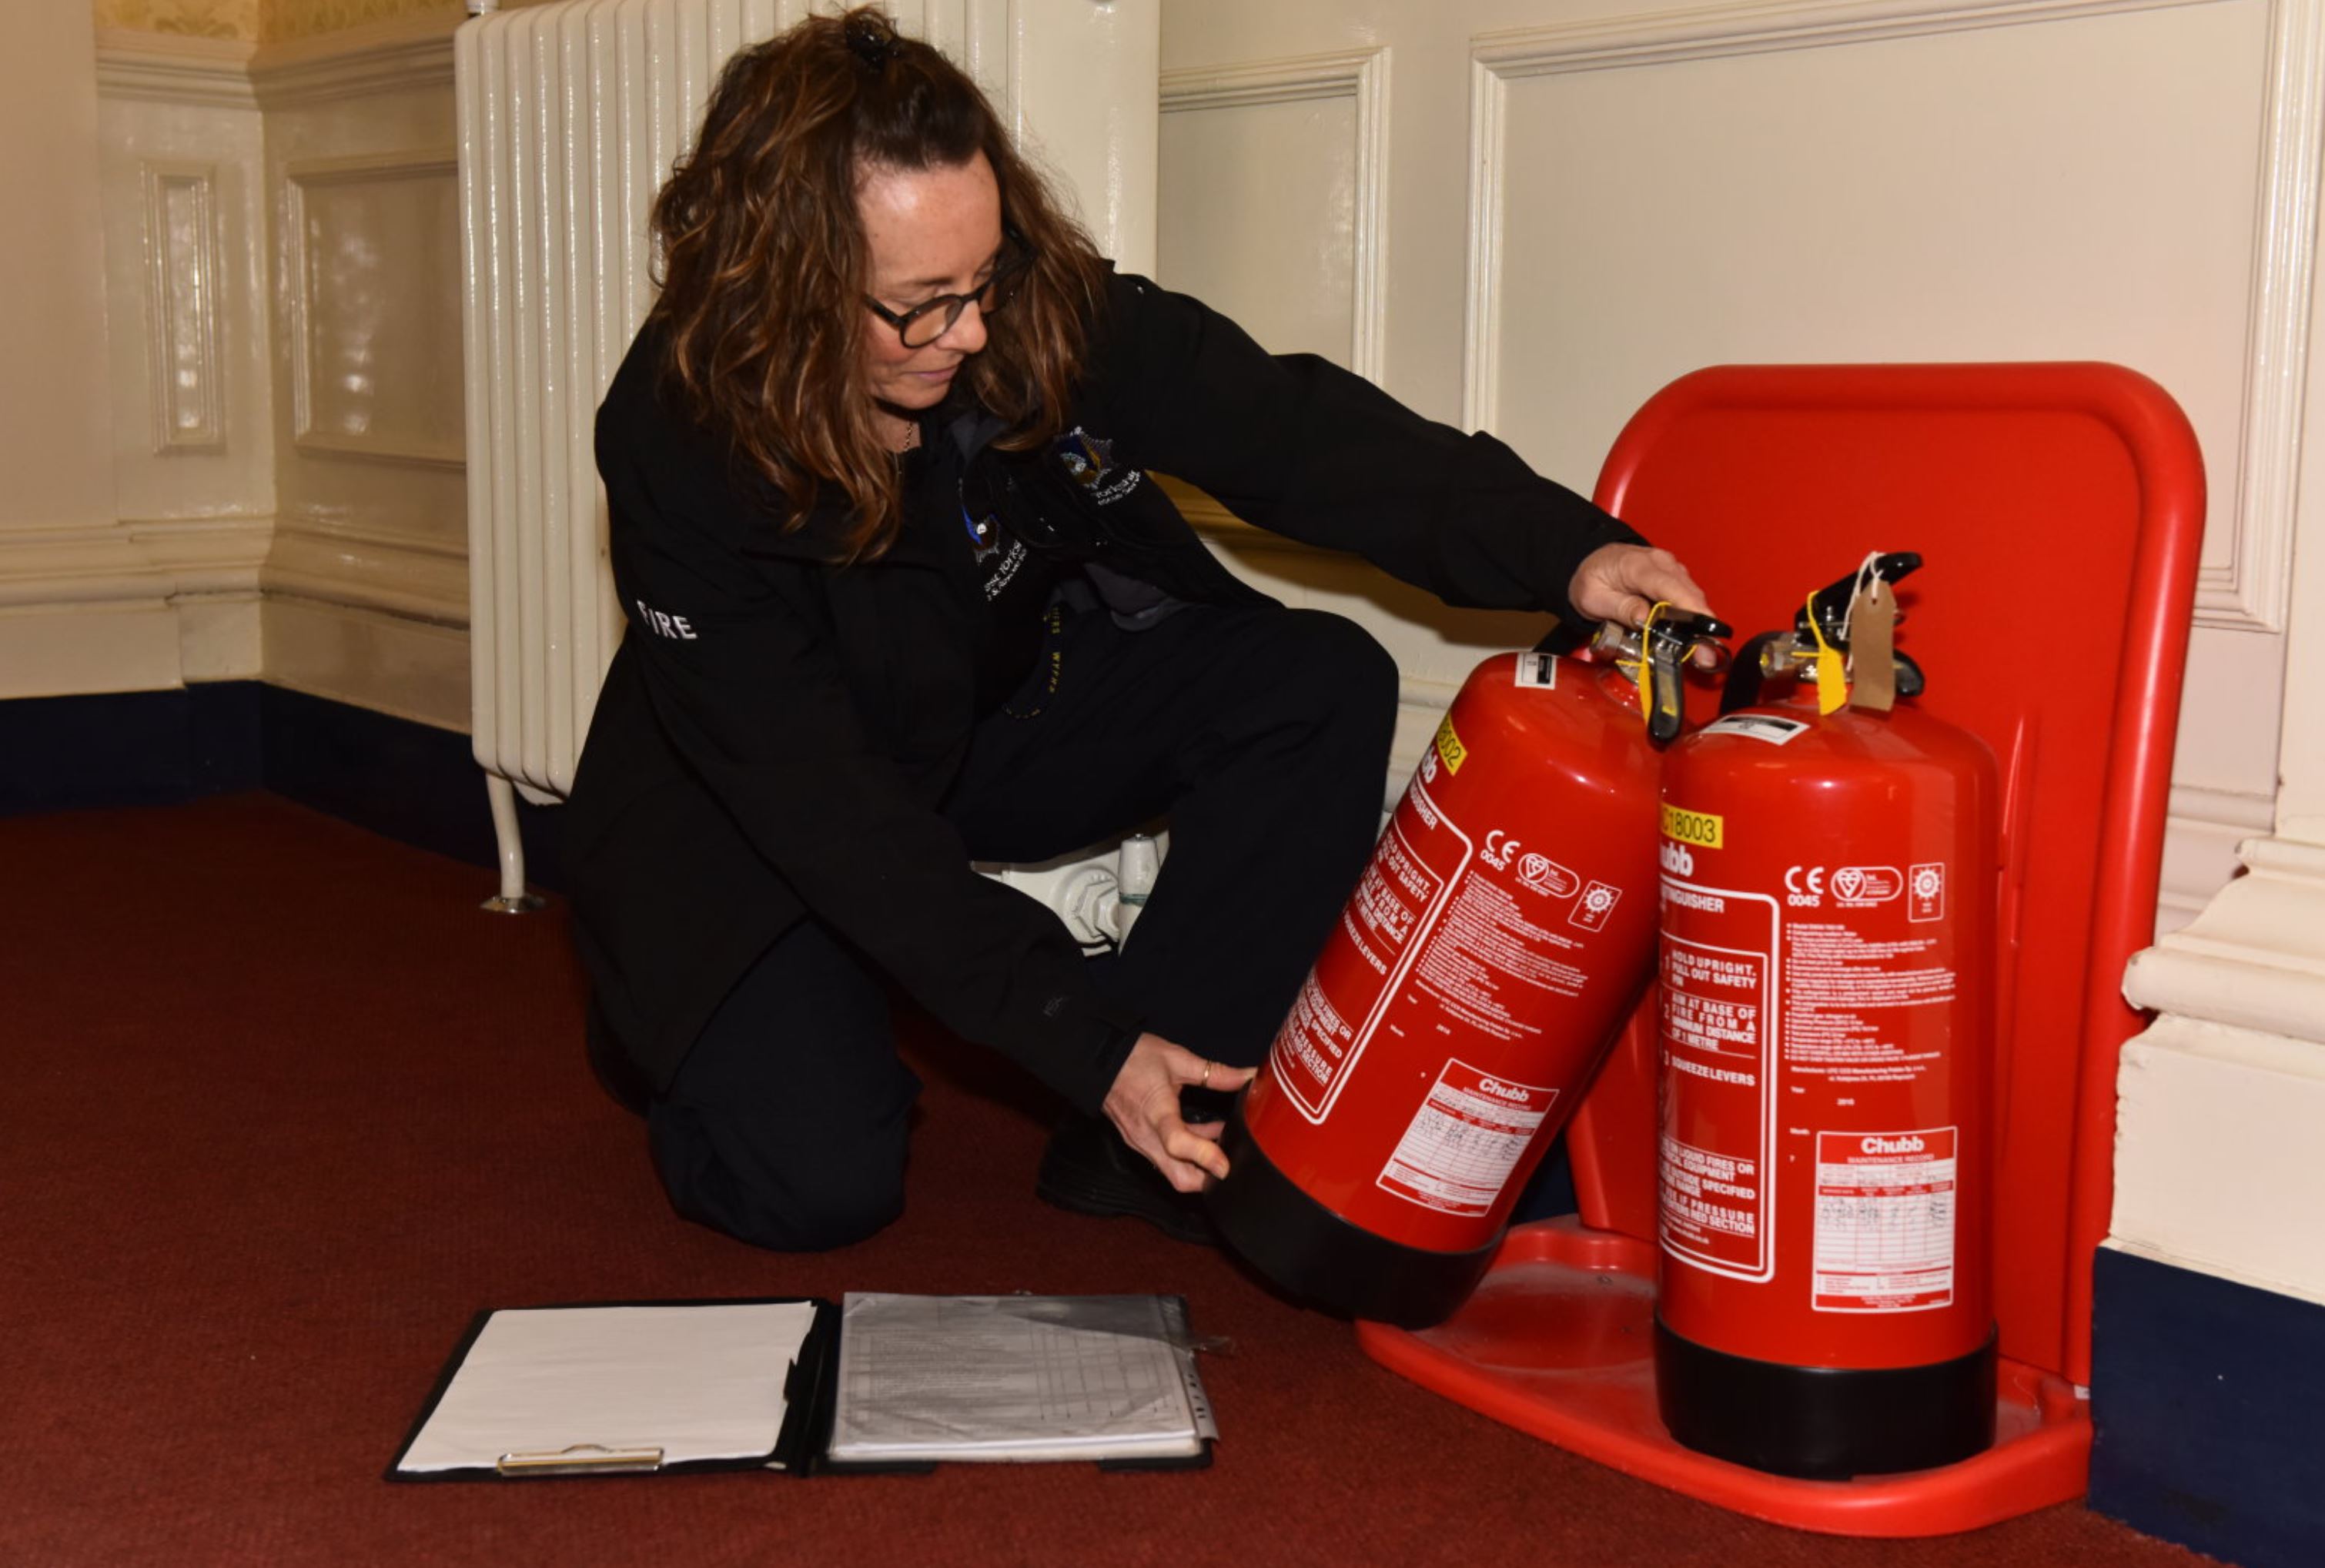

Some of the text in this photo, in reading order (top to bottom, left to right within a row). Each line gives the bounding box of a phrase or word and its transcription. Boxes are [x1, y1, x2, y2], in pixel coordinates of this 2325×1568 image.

[637, 599, 698, 640] FIRE
[1479, 849, 1506, 871] 0045
[1660, 841, 1693, 878] ubb
[1398, 871, 1427, 902] SAFETY
[1381, 887, 1400, 914] BASE
[1401, 911, 1415, 925] OF
[1787, 894, 1821, 908] 0045
[1374, 893, 1398, 924] FROM
[1399, 924, 1408, 938] A
[1359, 941, 1387, 976] LEVERS
[1691, 968, 1711, 981] OUT
[1713, 973, 1757, 988] SAFETY
[1671, 1003, 1756, 1032] FIRE FROM A
[1688, 997, 1700, 1010] AT
[1703, 1001, 1734, 1017] BASE
[1738, 1008, 1756, 1019] OF
[1340, 1025, 1352, 1041] OR
[1706, 1025, 1756, 1044] DISTANCE
[1711, 1068, 1755, 1086] LEVERS
[1479, 1078, 1530, 1102] Chubb
[1860, 1135, 1925, 1155] Chubb
[1706, 1155, 1735, 1171] FIRES
[1738, 1162, 1755, 1175] OR
[1702, 1179, 1755, 1199] SPECIFIED
[1691, 1199, 1755, 1225] PRESSURE
[1709, 1214, 1755, 1235] SECTION
